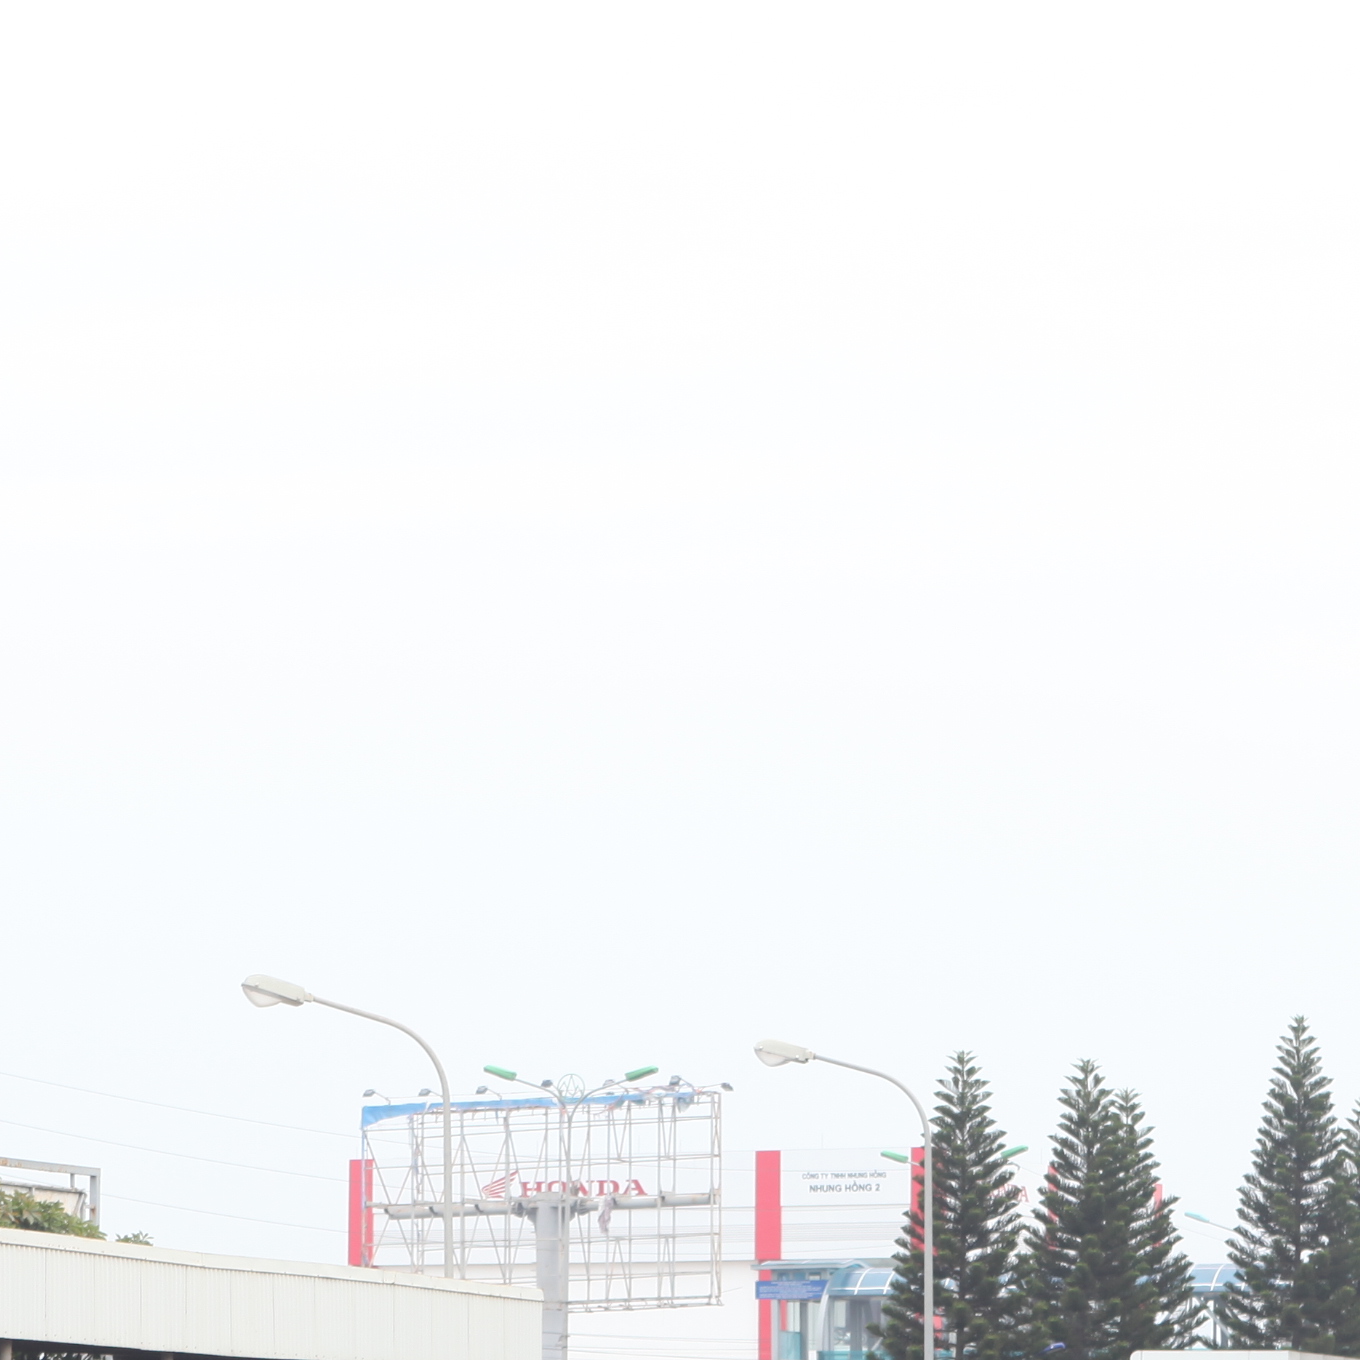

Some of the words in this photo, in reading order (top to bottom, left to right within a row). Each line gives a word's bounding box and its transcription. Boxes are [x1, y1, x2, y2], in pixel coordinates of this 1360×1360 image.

[802, 1171, 819, 1180] CÔNG
[519, 1179, 648, 1198] HONDA
[809, 1184, 842, 1193] NHUNG
[845, 1180, 872, 1192] HỒNG
[875, 1184, 880, 1192] 2
